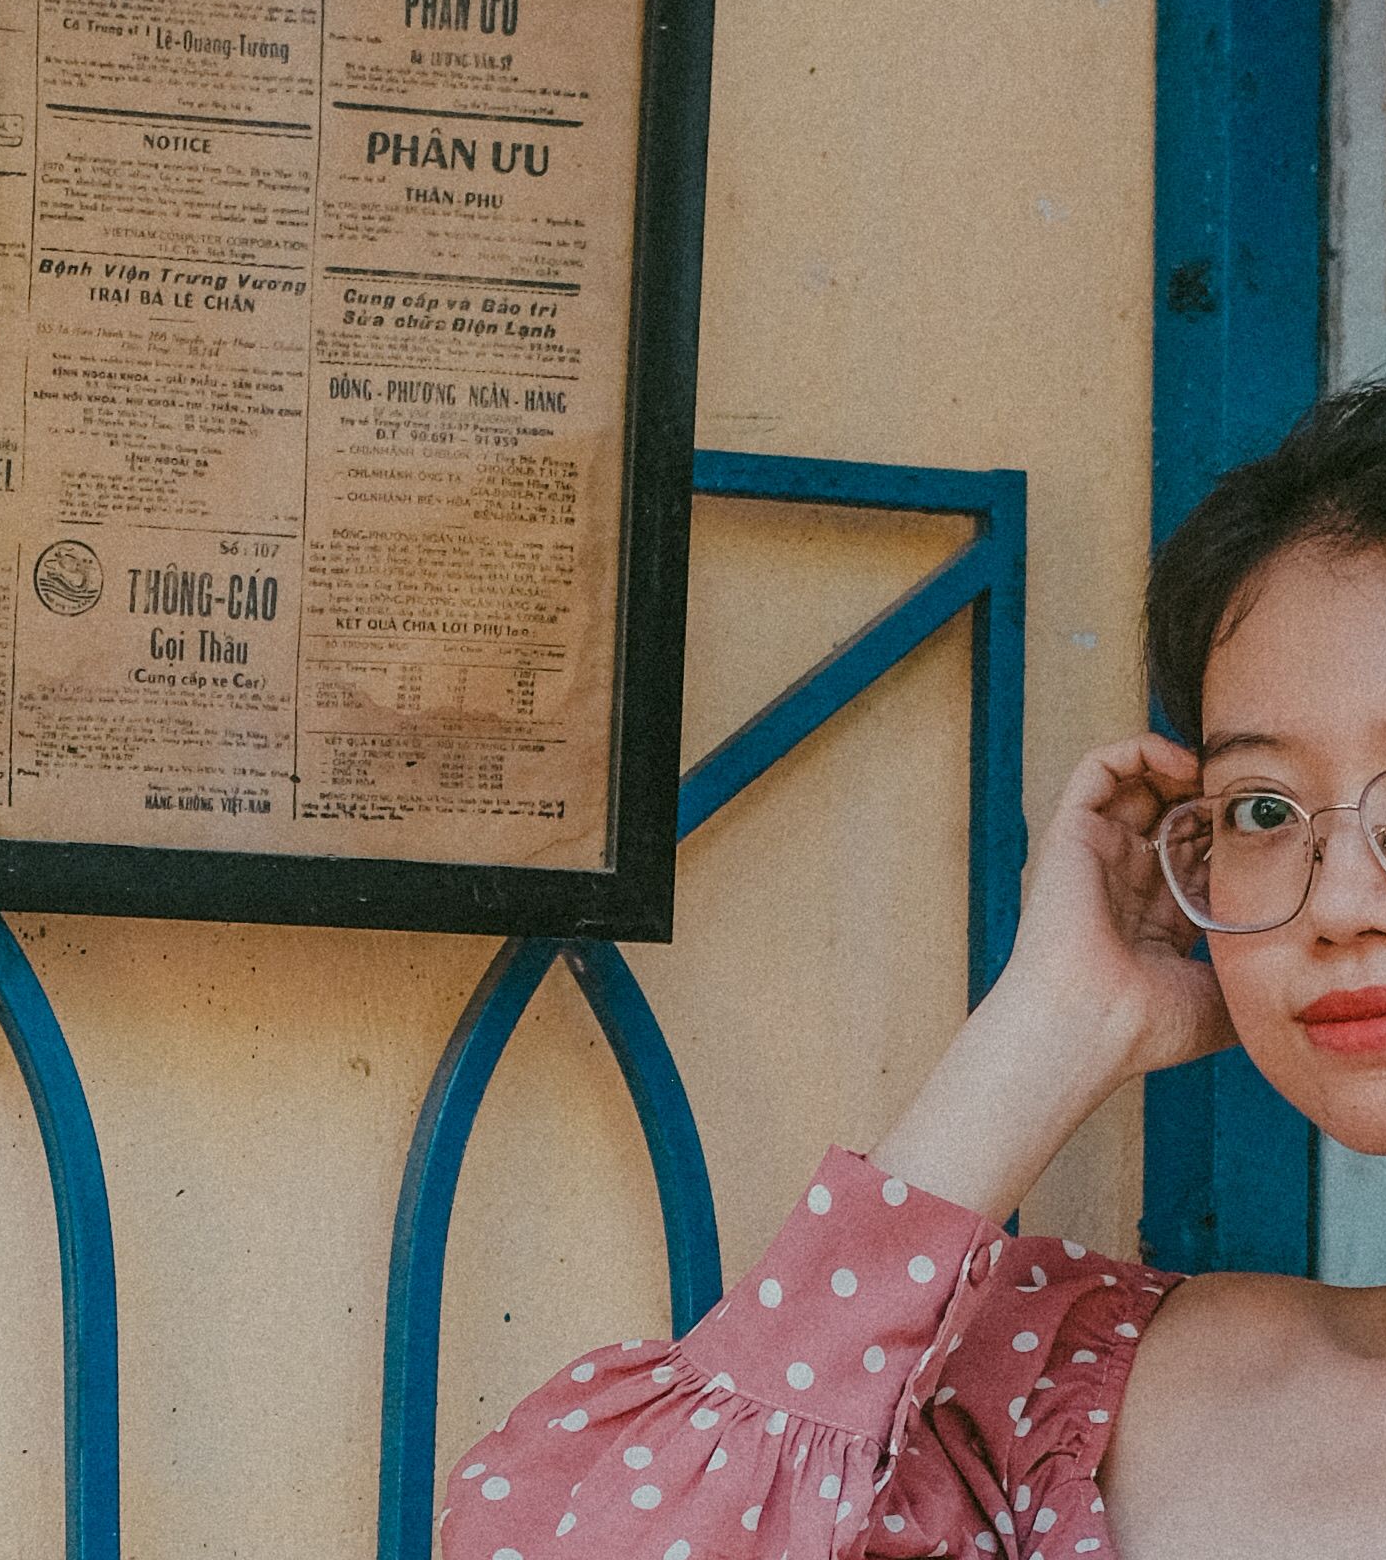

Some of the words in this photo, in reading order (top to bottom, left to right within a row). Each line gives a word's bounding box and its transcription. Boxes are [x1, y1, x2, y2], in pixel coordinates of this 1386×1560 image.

[143, 134, 212, 154] NOTICE
[367, 126, 477, 172] PHÂN
[491, 140, 550, 177] ƯU
[38, 258, 92, 277] Bệnh
[160, 269, 228, 290] Trưng
[238, 274, 307, 296] Vương
[343, 289, 396, 309] Cung
[402, 291, 439, 313] cấp
[505, 321, 557, 341] Lạnh
[253, 544, 280, 558] 107
[127, 562, 278, 621] THÔNG-CÁO
[402, 619, 437, 634] CHIA
